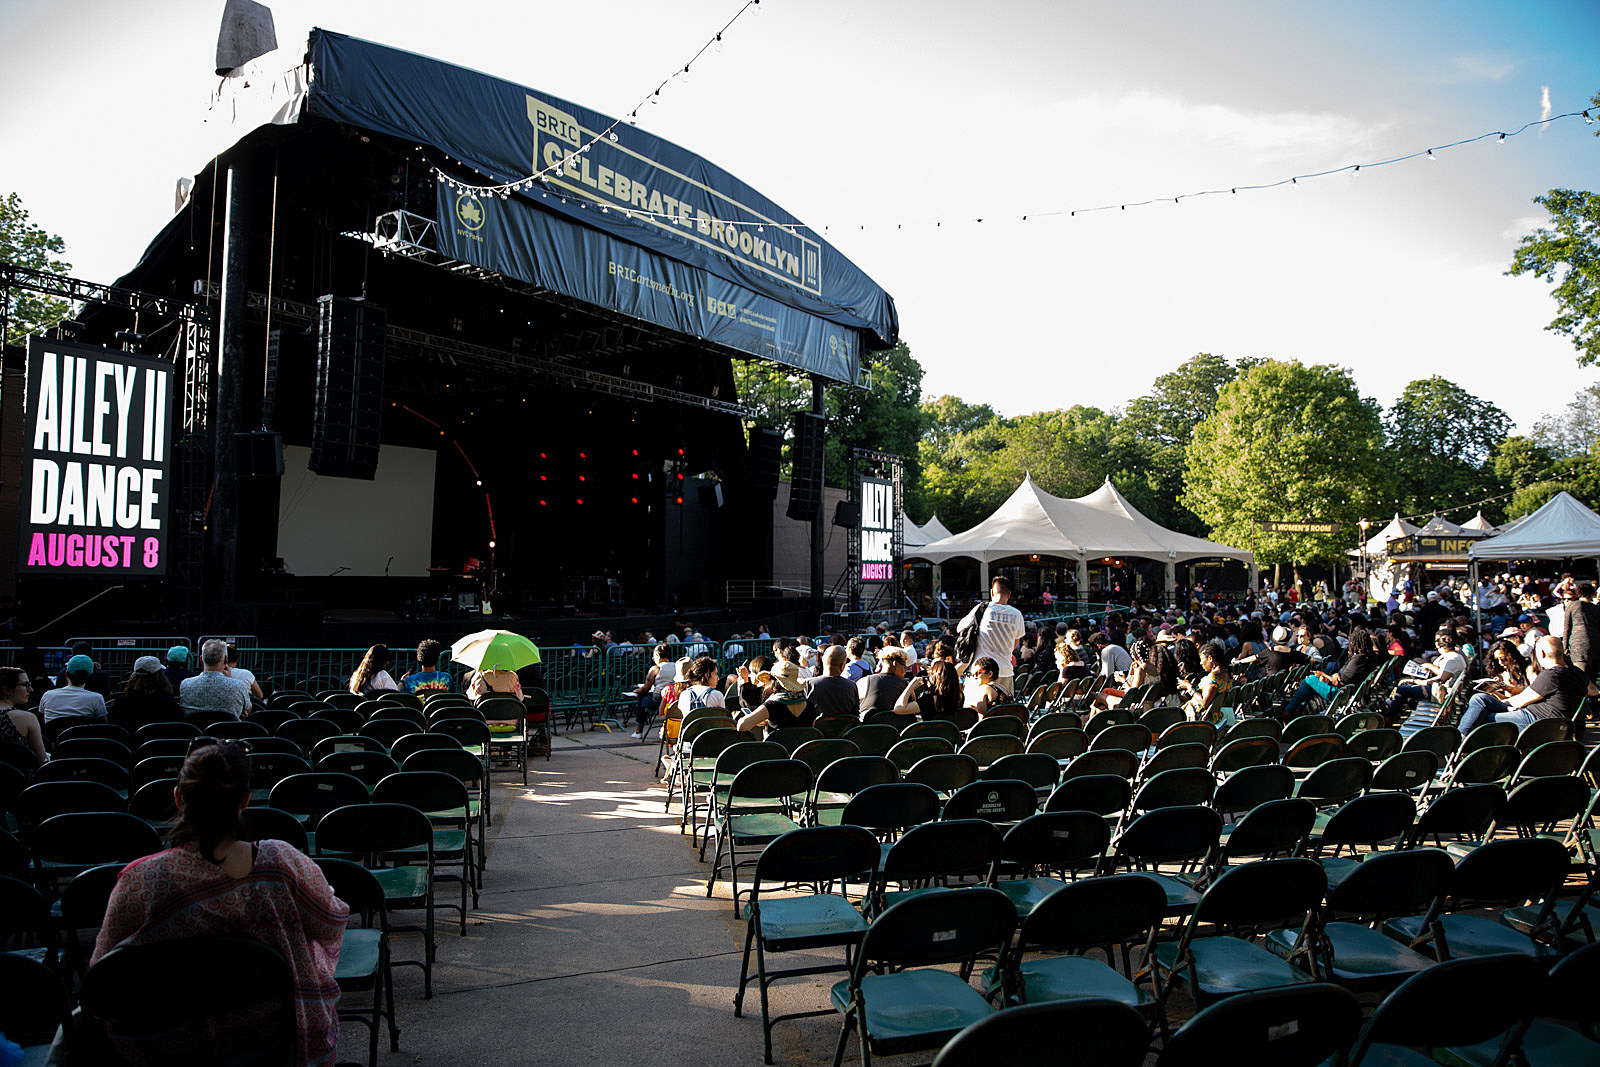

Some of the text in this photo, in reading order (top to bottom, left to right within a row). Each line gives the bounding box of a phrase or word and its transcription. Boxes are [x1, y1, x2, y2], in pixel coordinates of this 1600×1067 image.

[536, 109, 577, 143] BRIC
[543, 141, 693, 229] CELEBRATE
[696, 208, 799, 277] BROOKLYN
[33, 351, 167, 462] AILEY II
[30, 458, 163, 530] DANCE
[862, 482, 886, 529] AILEY
[861, 530, 893, 562] DANCE
[1310, 524, 1332, 532] ROOM
[27, 532, 160, 568] AUGUST 8
[861, 563, 893, 580] AUGUST 8
